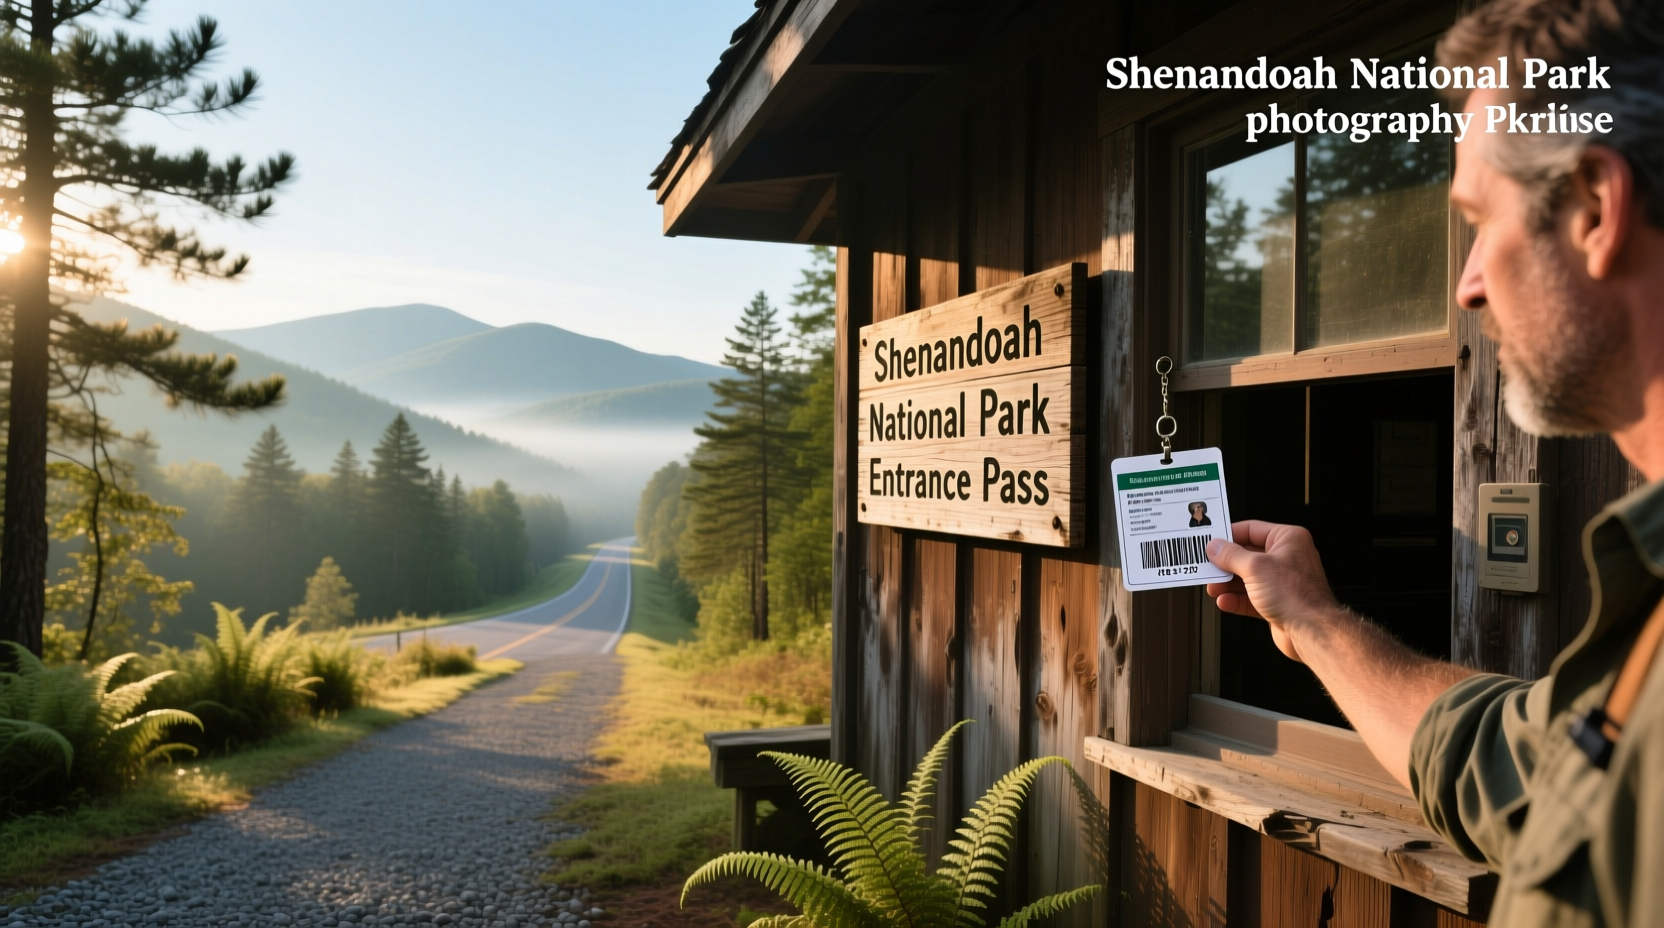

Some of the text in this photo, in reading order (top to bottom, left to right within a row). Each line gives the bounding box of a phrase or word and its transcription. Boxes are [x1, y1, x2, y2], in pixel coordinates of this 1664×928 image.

[874, 304, 1042, 383] Shenandoah
[870, 382, 1050, 441] National Park
[870, 456, 1050, 505] Entrance Pass
